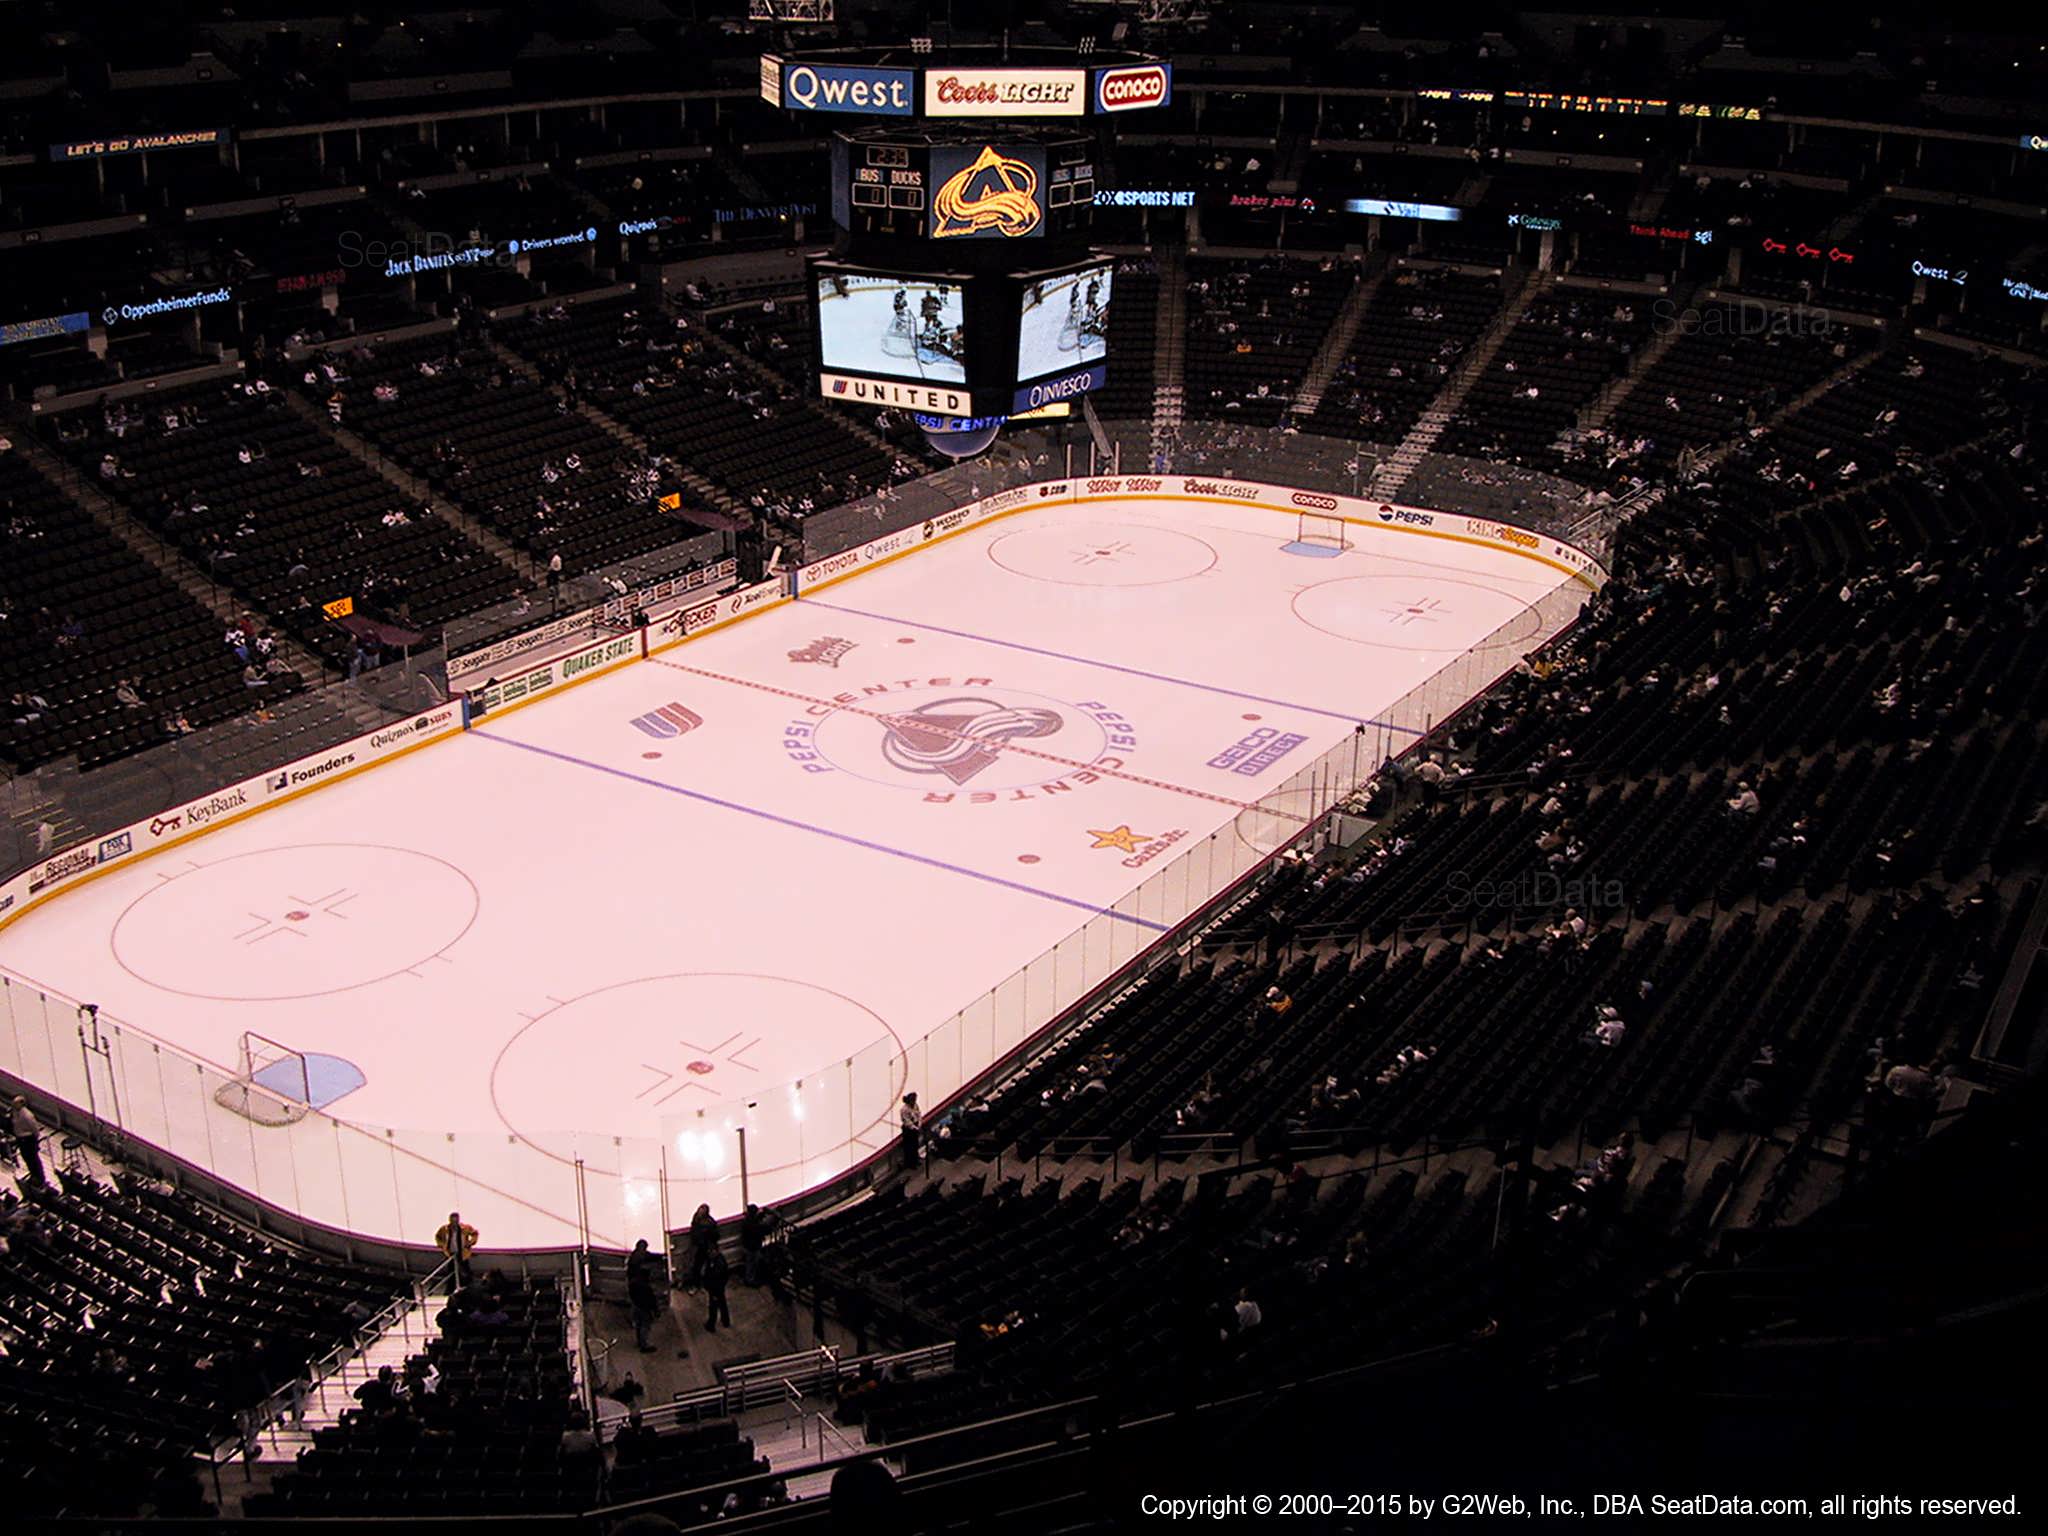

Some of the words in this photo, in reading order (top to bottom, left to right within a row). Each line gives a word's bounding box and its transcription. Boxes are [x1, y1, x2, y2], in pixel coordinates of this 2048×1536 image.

[789, 67, 908, 109] Qwest
[937, 77, 998, 103] Coors
[1000, 83, 1074, 103] LIGHT
[855, 382, 959, 409] UNITED
[1395, 510, 1435, 526] PEPSI
[822, 553, 859, 575] TOYOTA
[563, 651, 603, 678] QUAKER
[605, 637, 633, 663] STATE
[806, 677, 994, 716] CENTER
[1077, 701, 1137, 752] PEPSI
[783, 720, 835, 773] PEPSI
[1206, 726, 1280, 770] GEICO
[291, 752, 355, 784] Founders
[186, 788, 247, 824] KeyBank
